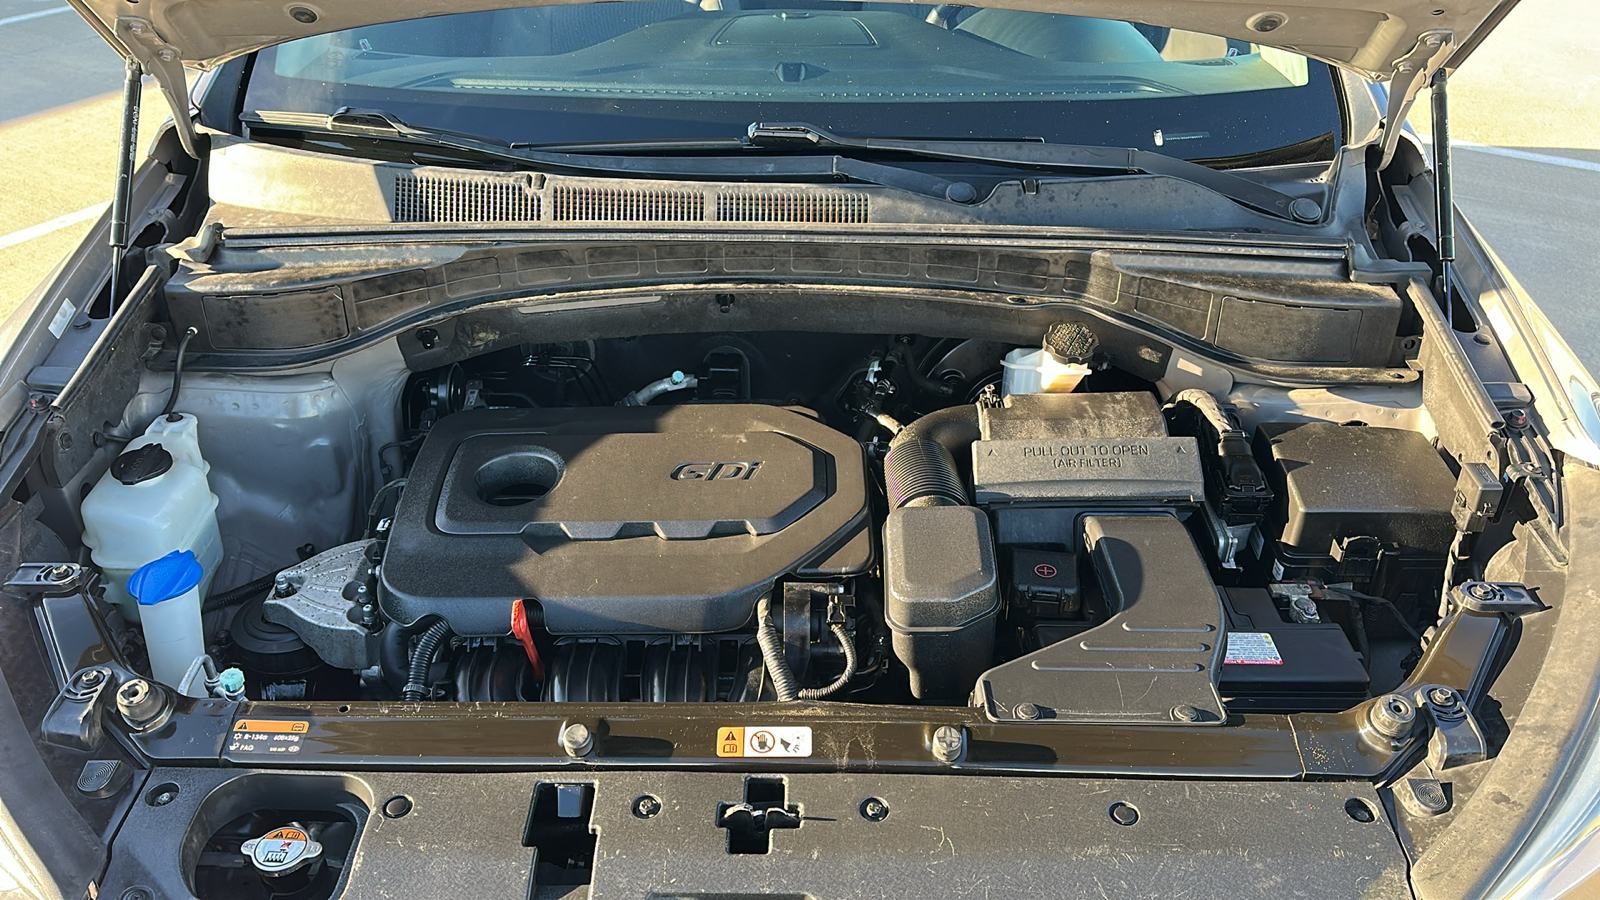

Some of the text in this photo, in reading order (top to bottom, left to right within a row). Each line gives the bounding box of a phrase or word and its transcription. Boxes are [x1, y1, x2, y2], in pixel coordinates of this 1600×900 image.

[1023, 444, 1149, 457] PULL OUT TO OPEN
[1053, 457, 1123, 469] (AIR FILTER)
